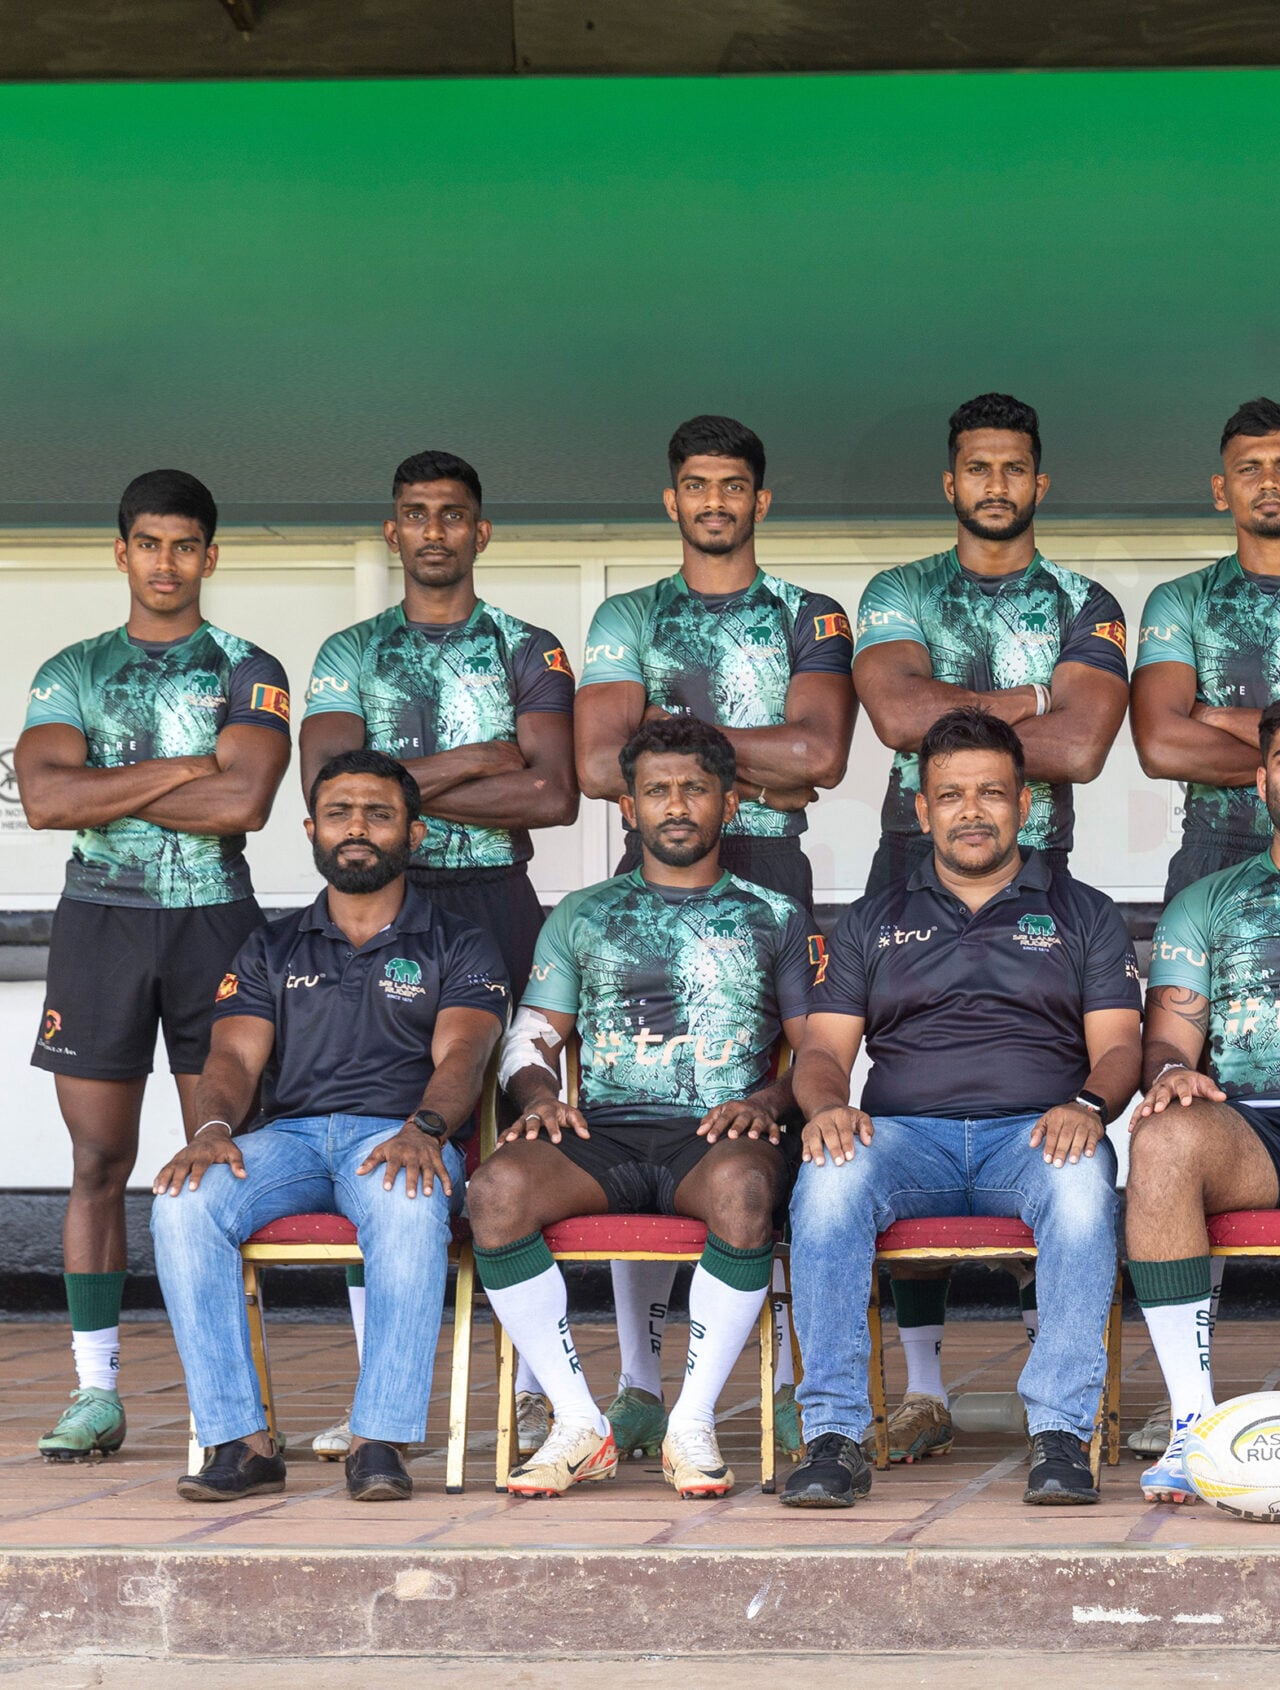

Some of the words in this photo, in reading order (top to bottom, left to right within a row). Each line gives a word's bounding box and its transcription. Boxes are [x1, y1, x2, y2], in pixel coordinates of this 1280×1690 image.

[893, 928, 932, 945] tru
[1160, 940, 1206, 968] tru
[286, 975, 320, 989] tru
[623, 1015, 645, 1026] BE
[632, 1028, 733, 1066] tru
[558, 1316, 582, 1375] SLR
[649, 1303, 667, 1357] SLR
[1196, 1309, 1210, 1371] SLR
